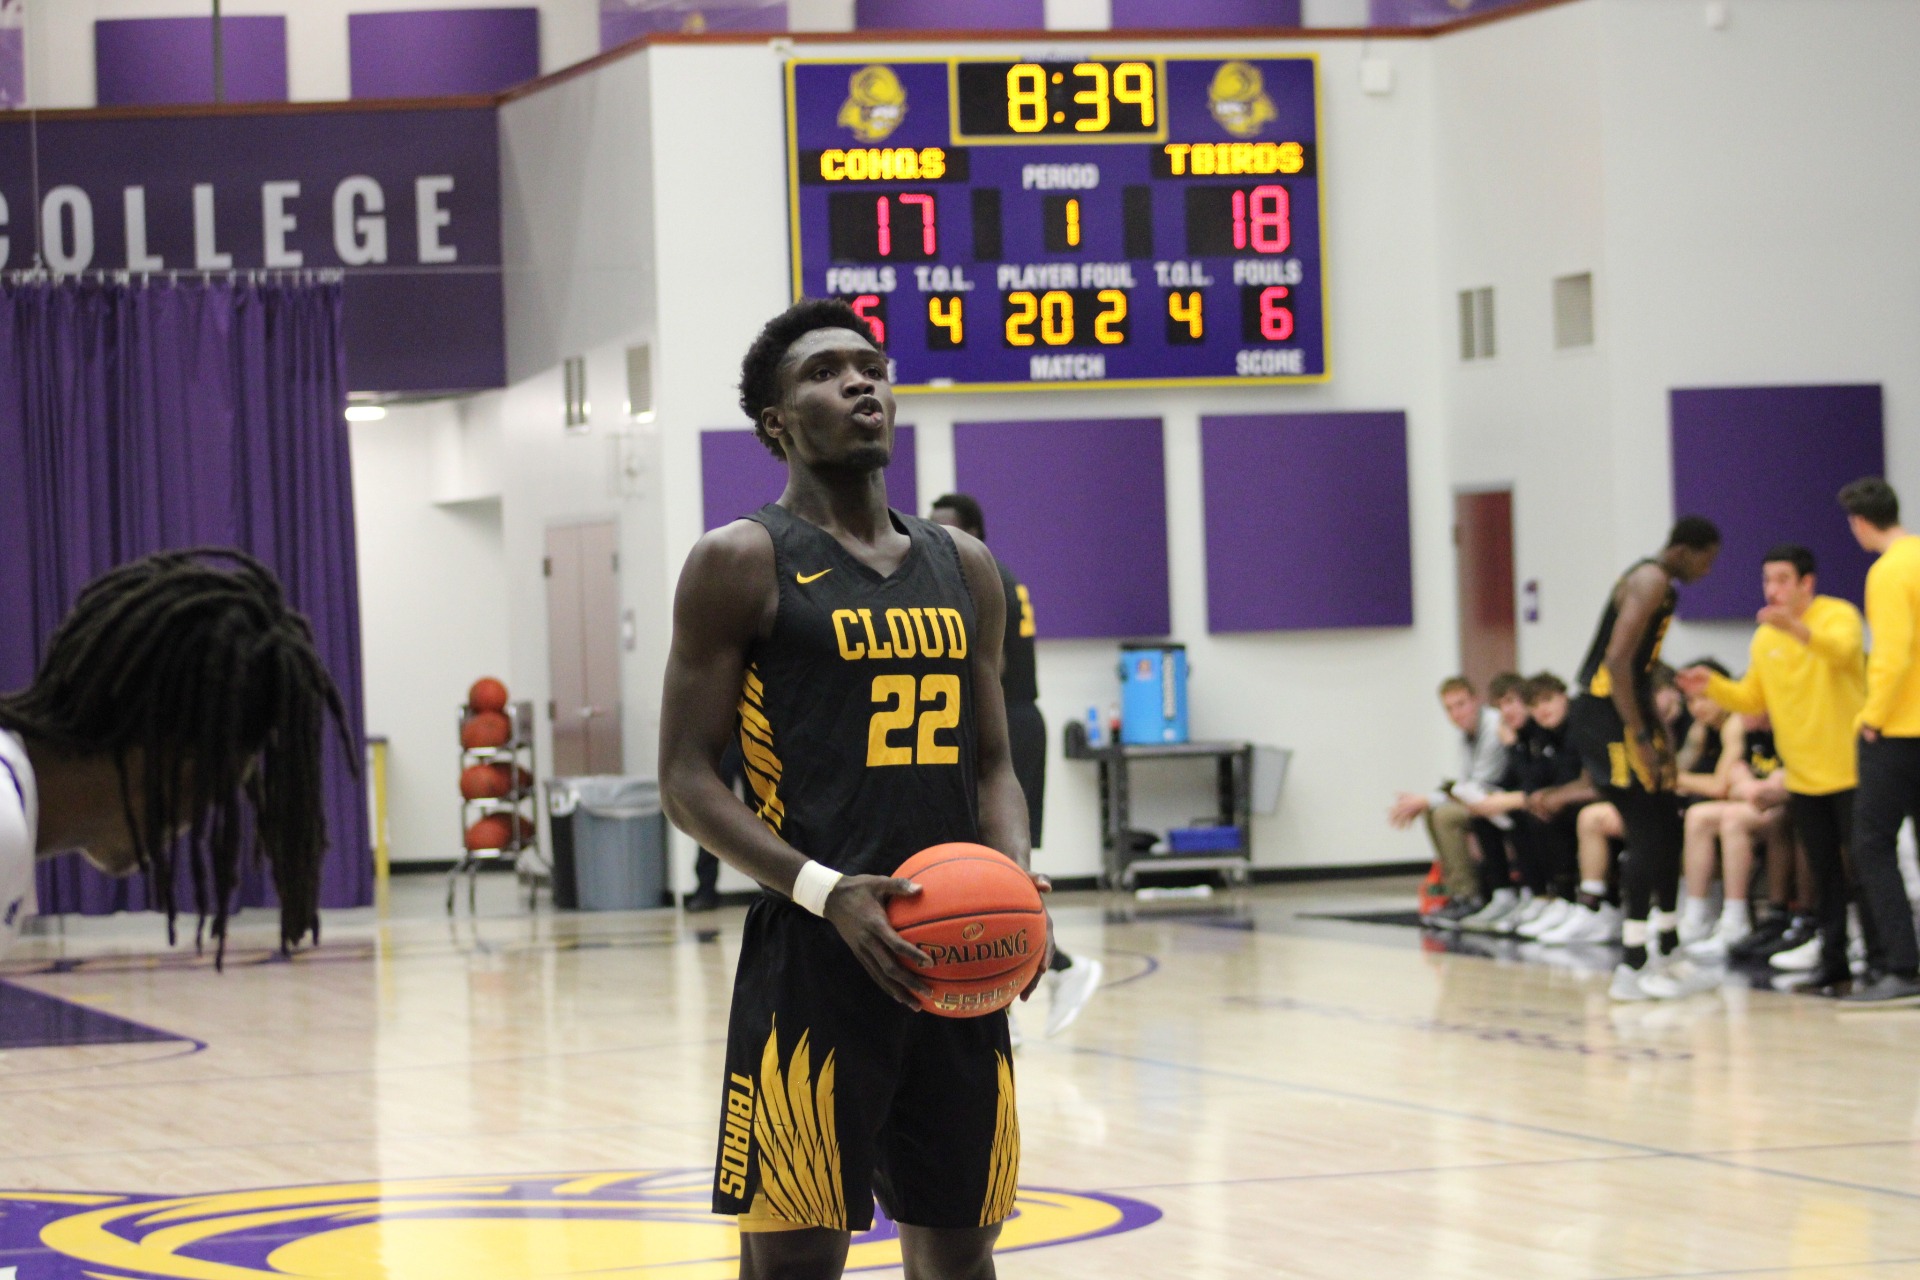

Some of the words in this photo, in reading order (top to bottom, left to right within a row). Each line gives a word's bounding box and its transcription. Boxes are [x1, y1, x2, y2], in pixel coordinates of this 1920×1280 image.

[1006, 63, 1154, 132] 8:39
[1022, 163, 1100, 190] PERIOD
[1164, 141, 1304, 175] TBIRDS
[0, 175, 458, 273] OLLEGE
[877, 193, 936, 256] 17
[1066, 199, 1080, 246] 1
[1231, 185, 1291, 253] 18
[826, 266, 897, 293] FOULS
[914, 266, 974, 292] T.O.L.
[996, 263, 1079, 290] PLAYER
[1081, 262, 1136, 289] FOUL
[1154, 260, 1212, 288] T.O.L.
[1233, 258, 1303, 286] FOULS
[929, 297, 963, 344] 4
[1005, 290, 1074, 346] 20
[1094, 289, 1127, 344] 2
[1169, 292, 1203, 338] 4
[1259, 286, 1294, 341] 6
[1029, 353, 1106, 381] MATCH
[1235, 348, 1303, 377] SCORE
[831, 607, 968, 661] CLOUD
[865, 673, 961, 767] 22
[719, 1072, 754, 1200] TBIRDS
